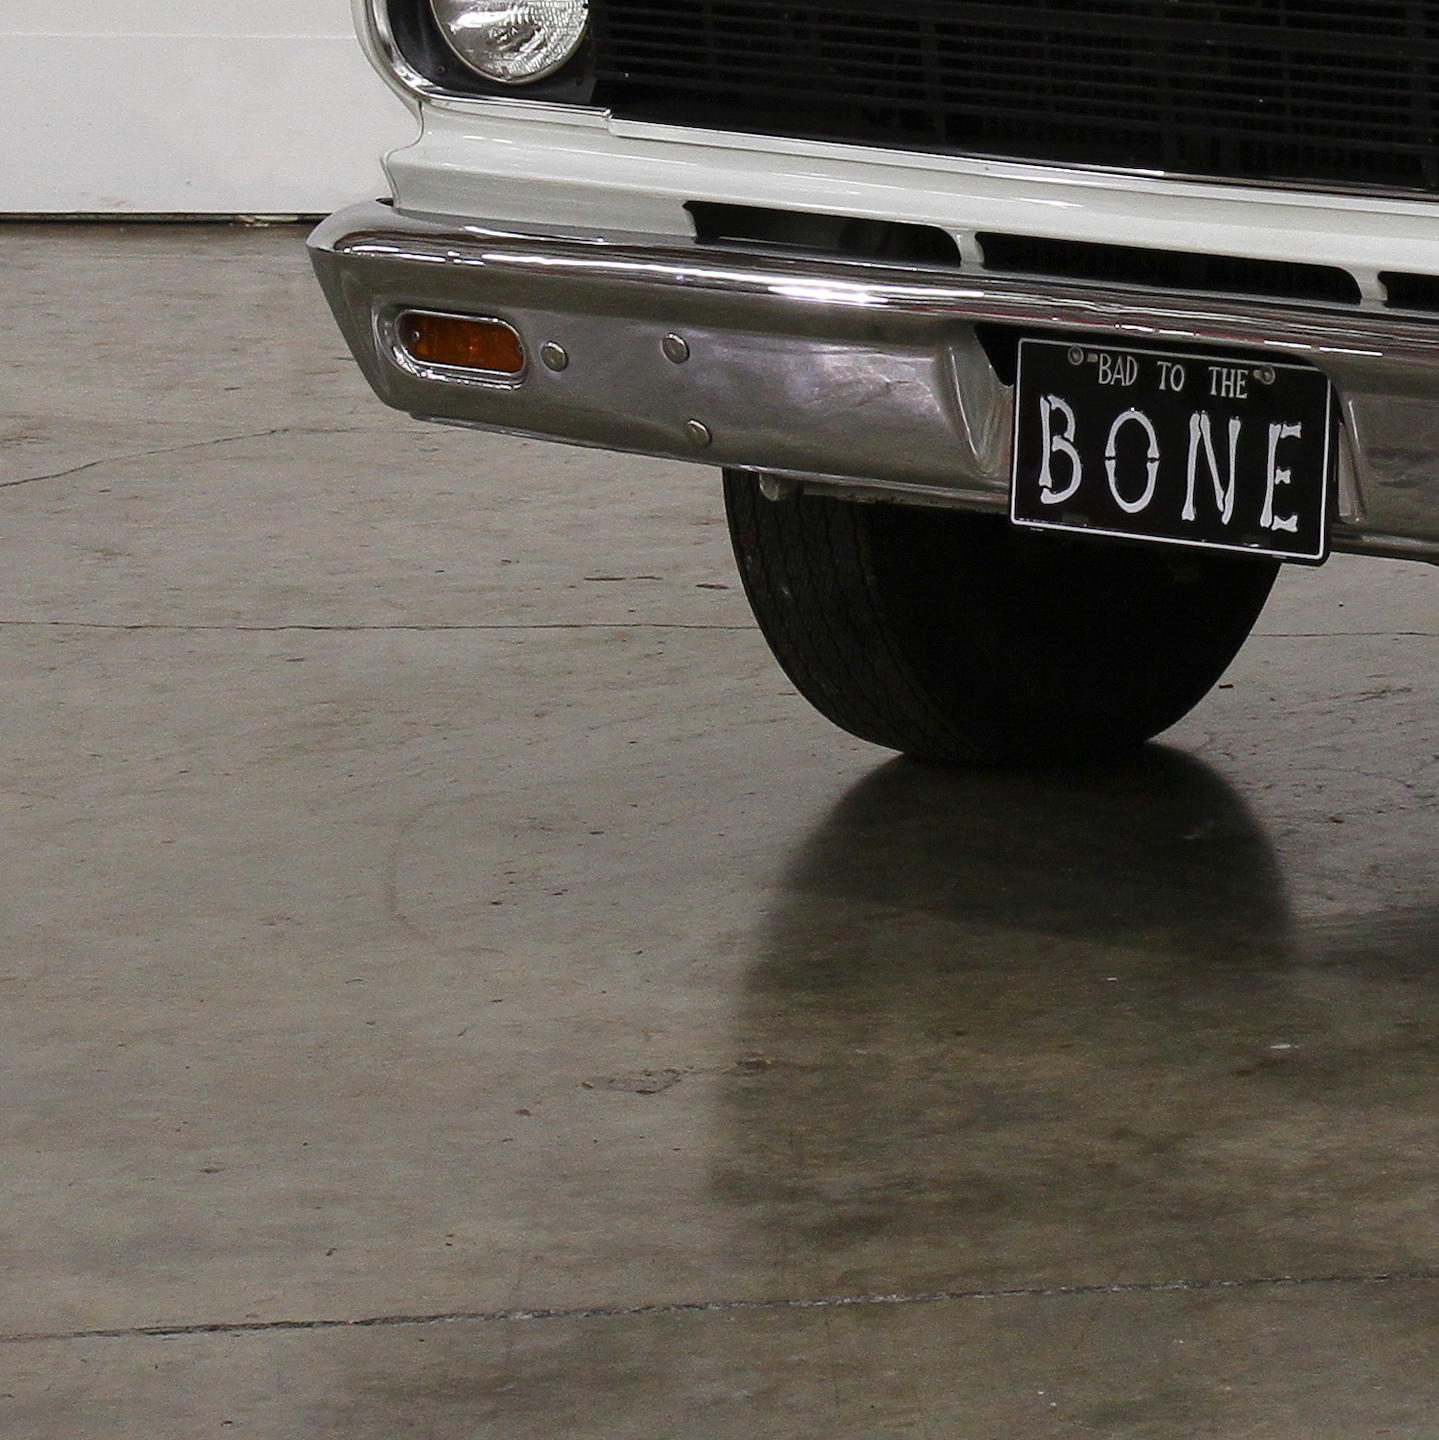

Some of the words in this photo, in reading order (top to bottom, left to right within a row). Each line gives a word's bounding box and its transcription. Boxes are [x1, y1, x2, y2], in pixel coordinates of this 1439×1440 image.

[1098, 352, 1138, 387] BAD
[1157, 360, 1186, 393] TO
[1208, 366, 1249, 399] THE
[1038, 393, 1303, 533] BONE
